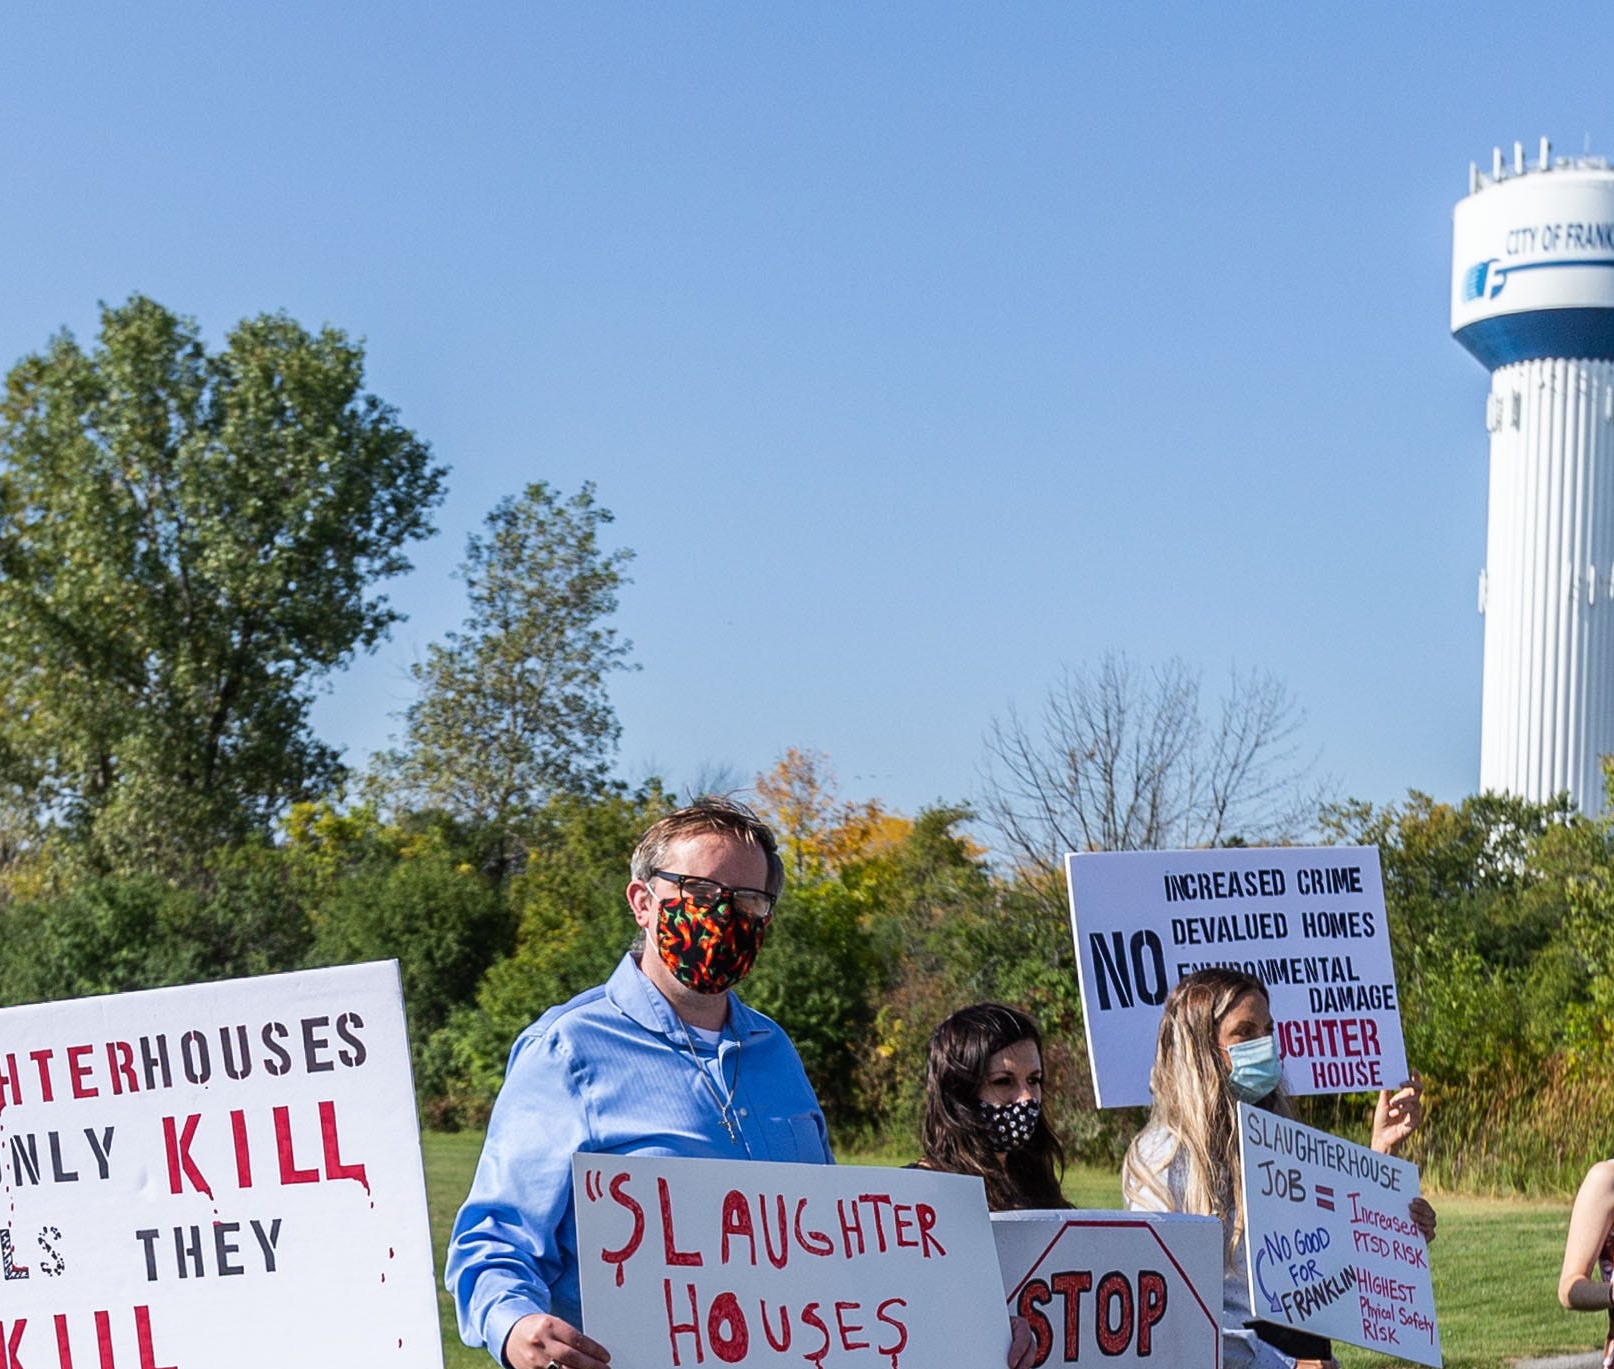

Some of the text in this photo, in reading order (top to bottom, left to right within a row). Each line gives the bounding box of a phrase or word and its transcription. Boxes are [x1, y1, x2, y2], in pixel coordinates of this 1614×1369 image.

[1506, 228, 1537, 255] CITY
[1543, 224, 1562, 251] OF
[1164, 867, 1363, 902] INCREASED CRIME
[1172, 912, 1375, 945] DEVALUED HOMES
[1089, 930, 1169, 1011] NO
[1309, 985, 1396, 1013] DAMAGE
[1312, 1061, 1383, 1088] HOUSE
[162, 1101, 371, 1198] KILL
[1247, 1112, 1402, 1192] SLAUGHTERHOUSE
[1258, 1160, 1306, 1202] JOB
[136, 1218, 283, 1282] THEY
[1264, 1228, 1330, 1265] NO GOOD
[1353, 1230, 1427, 1269] PTSD RISK
[1289, 1259, 1323, 1287] FOR
[1356, 1267, 1416, 1304] HIGHEST
[1281, 1265, 1357, 1324] FRANKLIN
[1017, 1270, 1167, 1369] STOP
[1399, 1306, 1434, 1345] Safety
